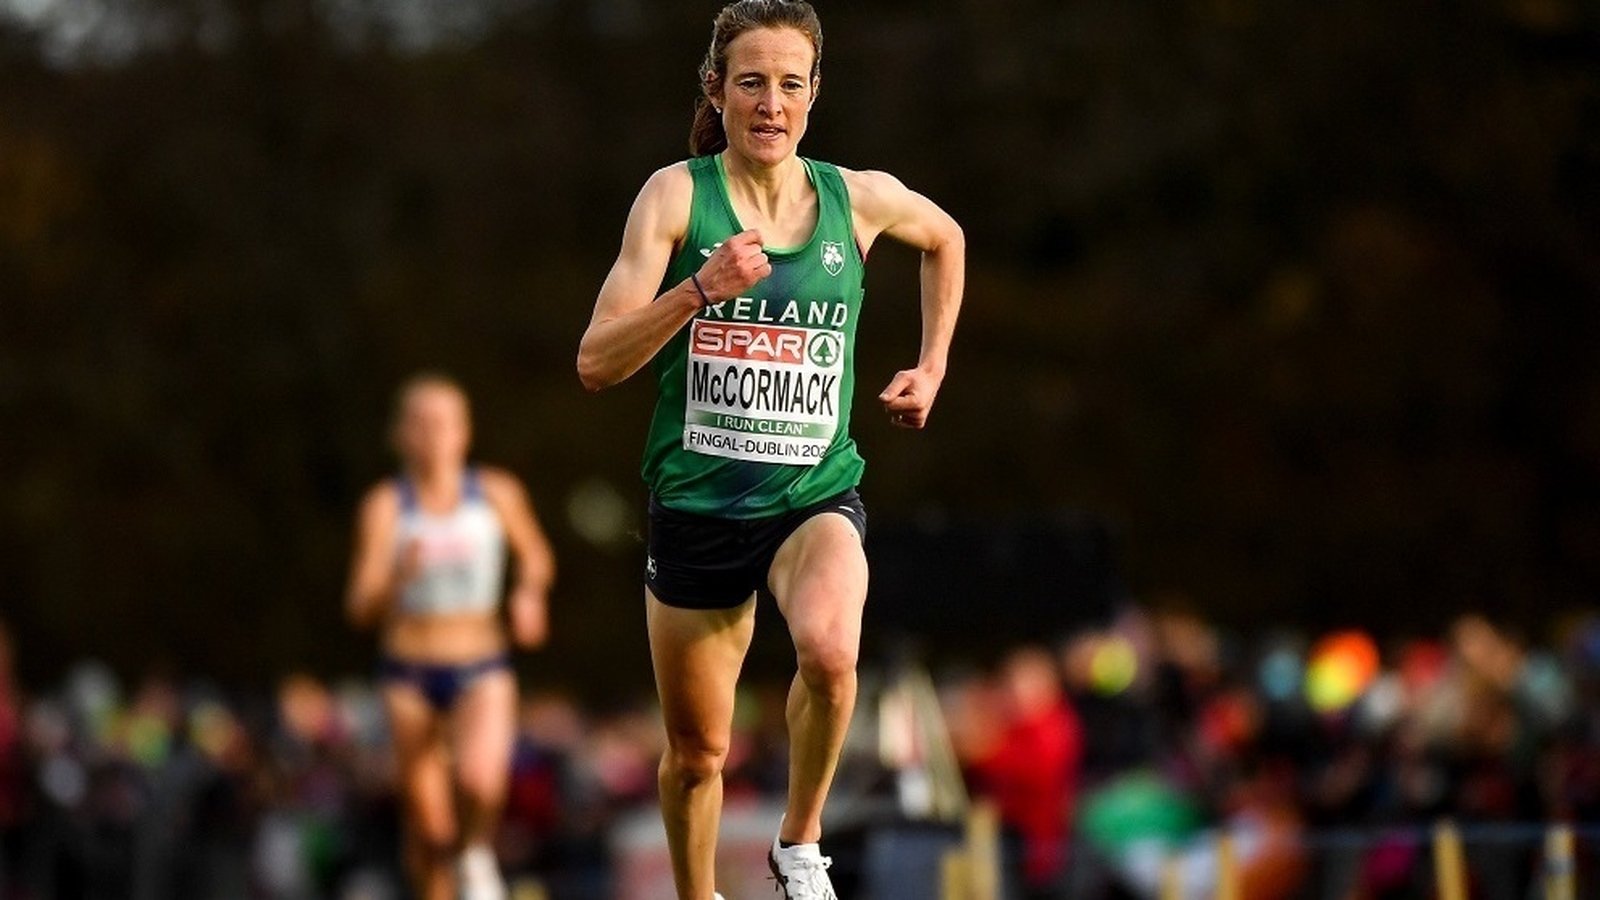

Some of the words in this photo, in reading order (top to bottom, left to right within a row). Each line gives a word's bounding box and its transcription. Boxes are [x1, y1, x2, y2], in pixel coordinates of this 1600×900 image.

[704, 297, 849, 328] RELAND
[696, 327, 803, 360] SPAR
[691, 360, 837, 417] McCORMACK
[716, 415, 722, 427] I
[724, 415, 754, 432] RUN
[689, 431, 799, 457] FINGAL-DUBLIN
